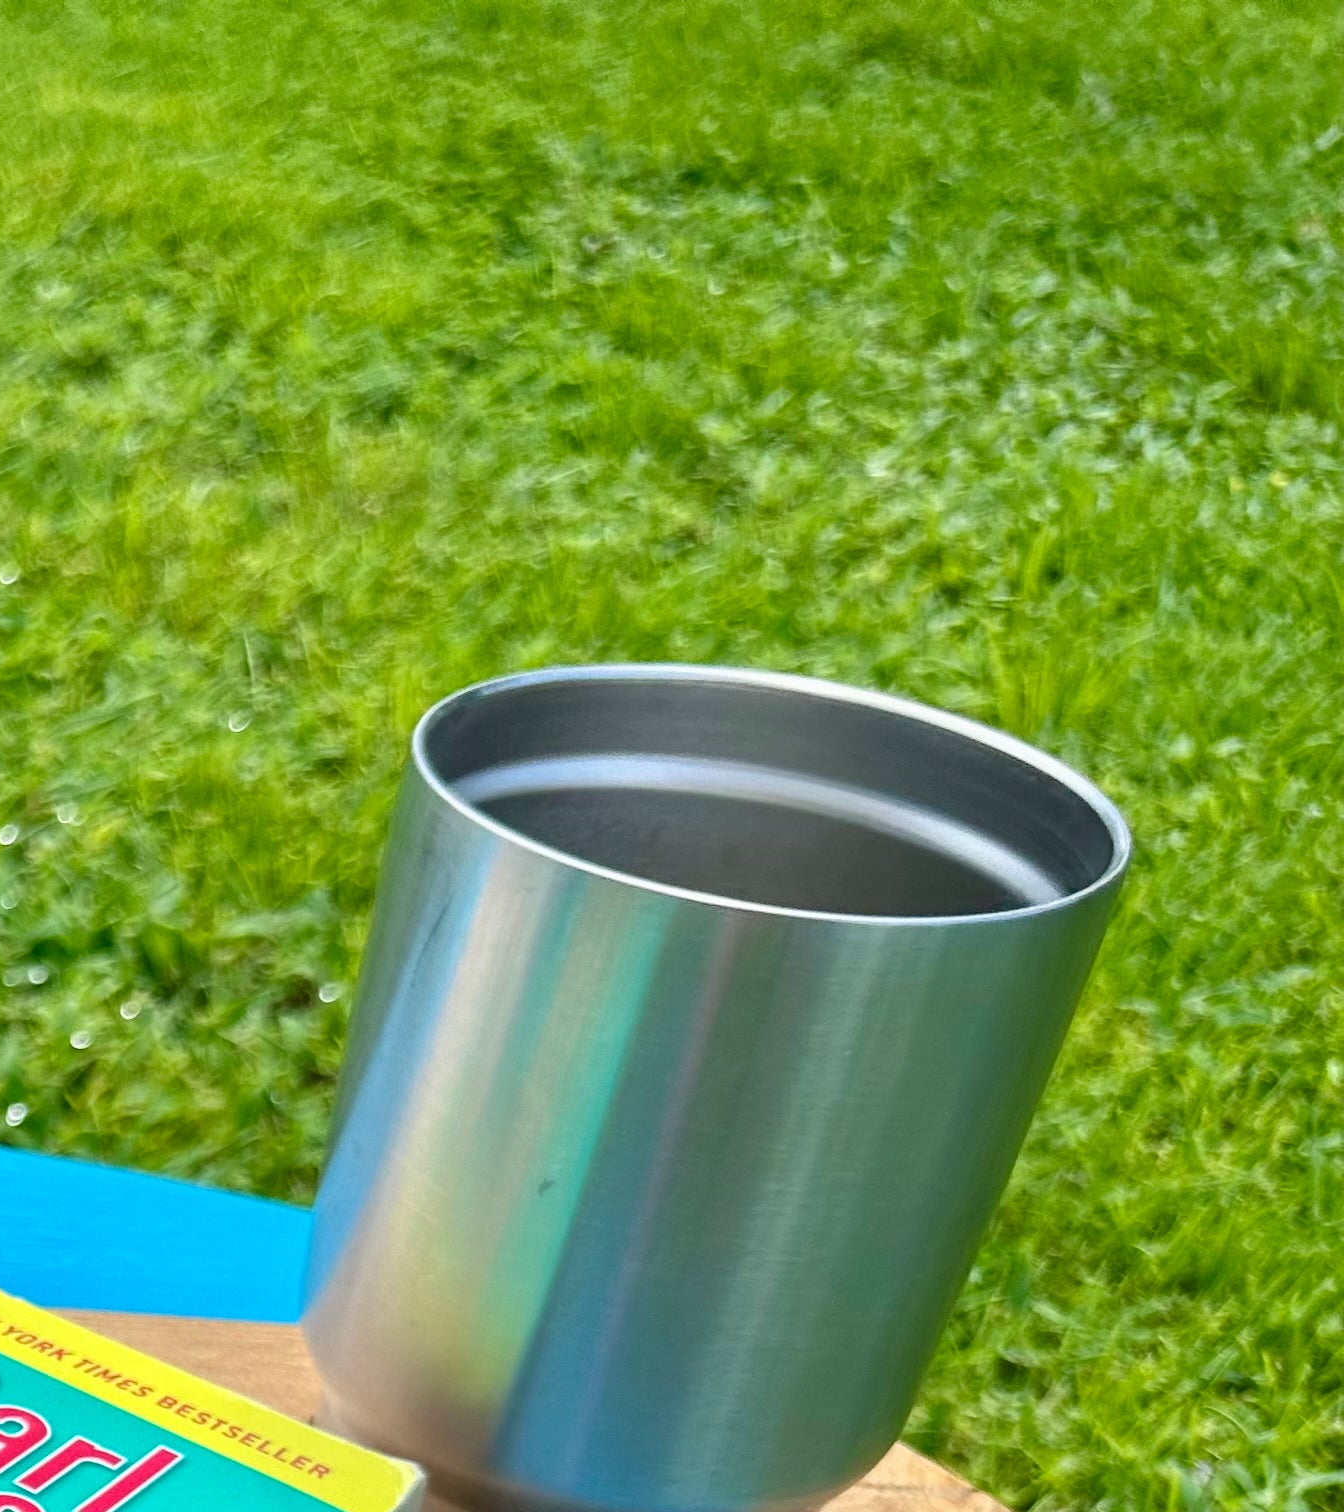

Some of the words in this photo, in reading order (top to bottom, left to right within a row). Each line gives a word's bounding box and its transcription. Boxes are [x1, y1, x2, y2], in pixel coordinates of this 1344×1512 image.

[1, 1325, 75, 1362] YORK
[73, 1358, 160, 1398] TIMES
[156, 1395, 332, 1480] BESTSELLER
